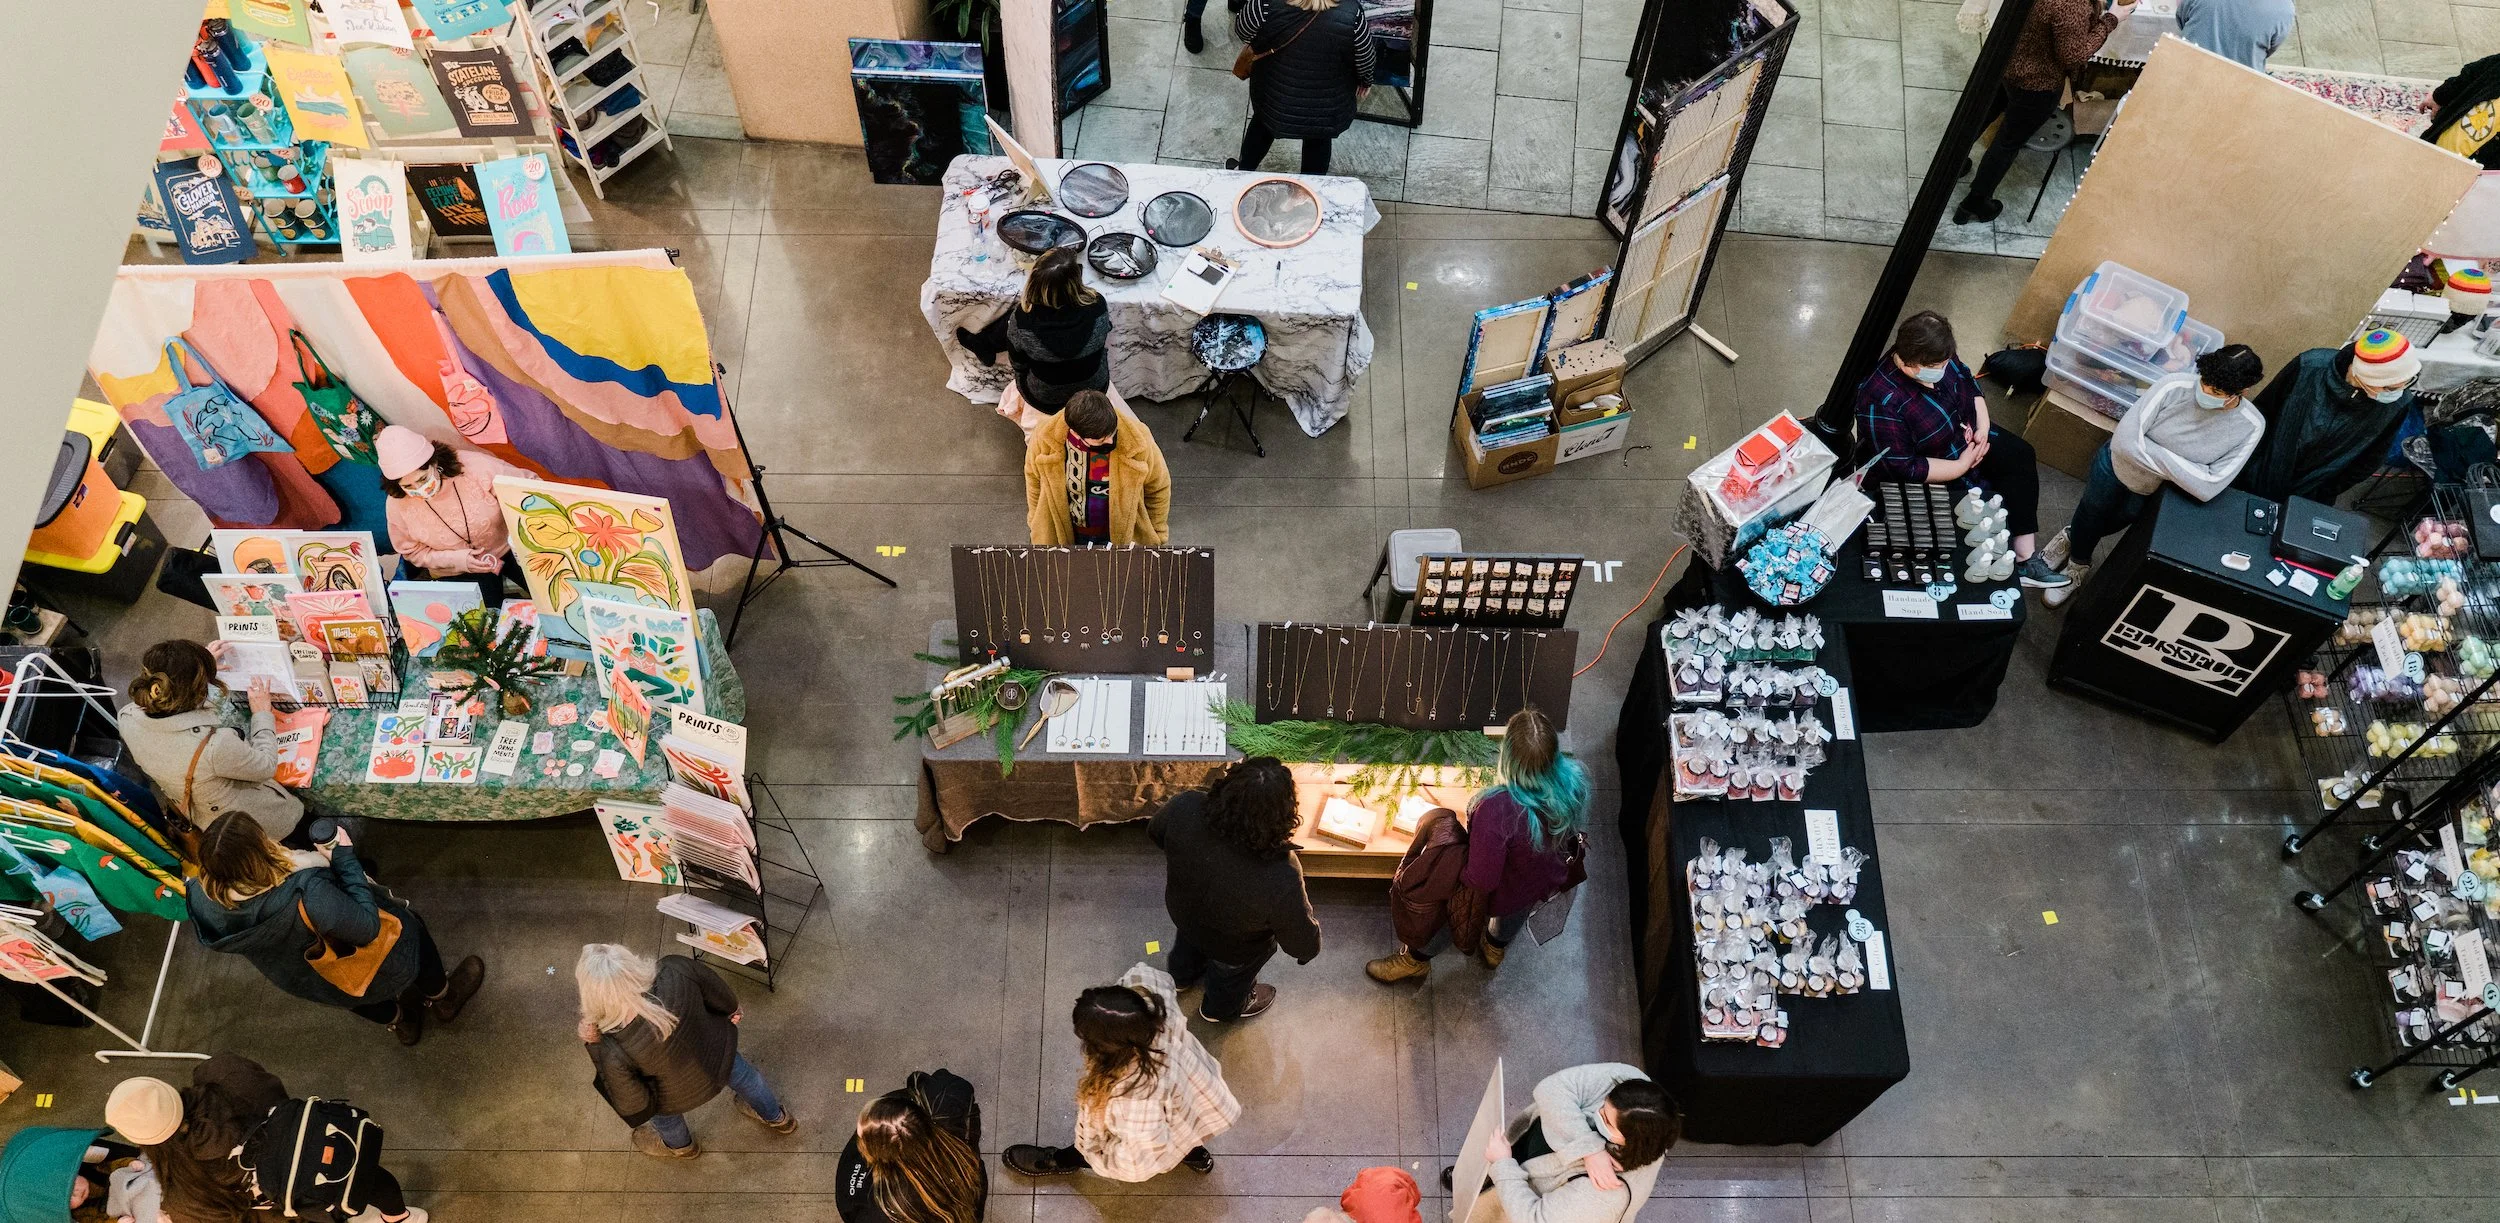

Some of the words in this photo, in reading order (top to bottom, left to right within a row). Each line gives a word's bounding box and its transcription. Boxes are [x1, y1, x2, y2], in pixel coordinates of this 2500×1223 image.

[448, 65, 500, 86] STATELINE
[485, 89, 507, 97] FRIDAY
[178, 180, 220, 211] GLOVER
[345, 188, 394, 220] Scoop
[1901, 606, 1922, 615] Soap
[1960, 608, 1980, 616] Hand
[1987, 607, 2009, 617] Soap
[228, 621, 259, 632] PRINTS
[2114, 622, 2246, 682] BLISSFUL
[678, 711, 723, 734] PRINTS
[499, 736, 518, 745] TREE
[492, 750, 515, 758] MENTS
[849, 1163, 862, 1196] STUDIO
[856, 1171, 867, 1189] THE
